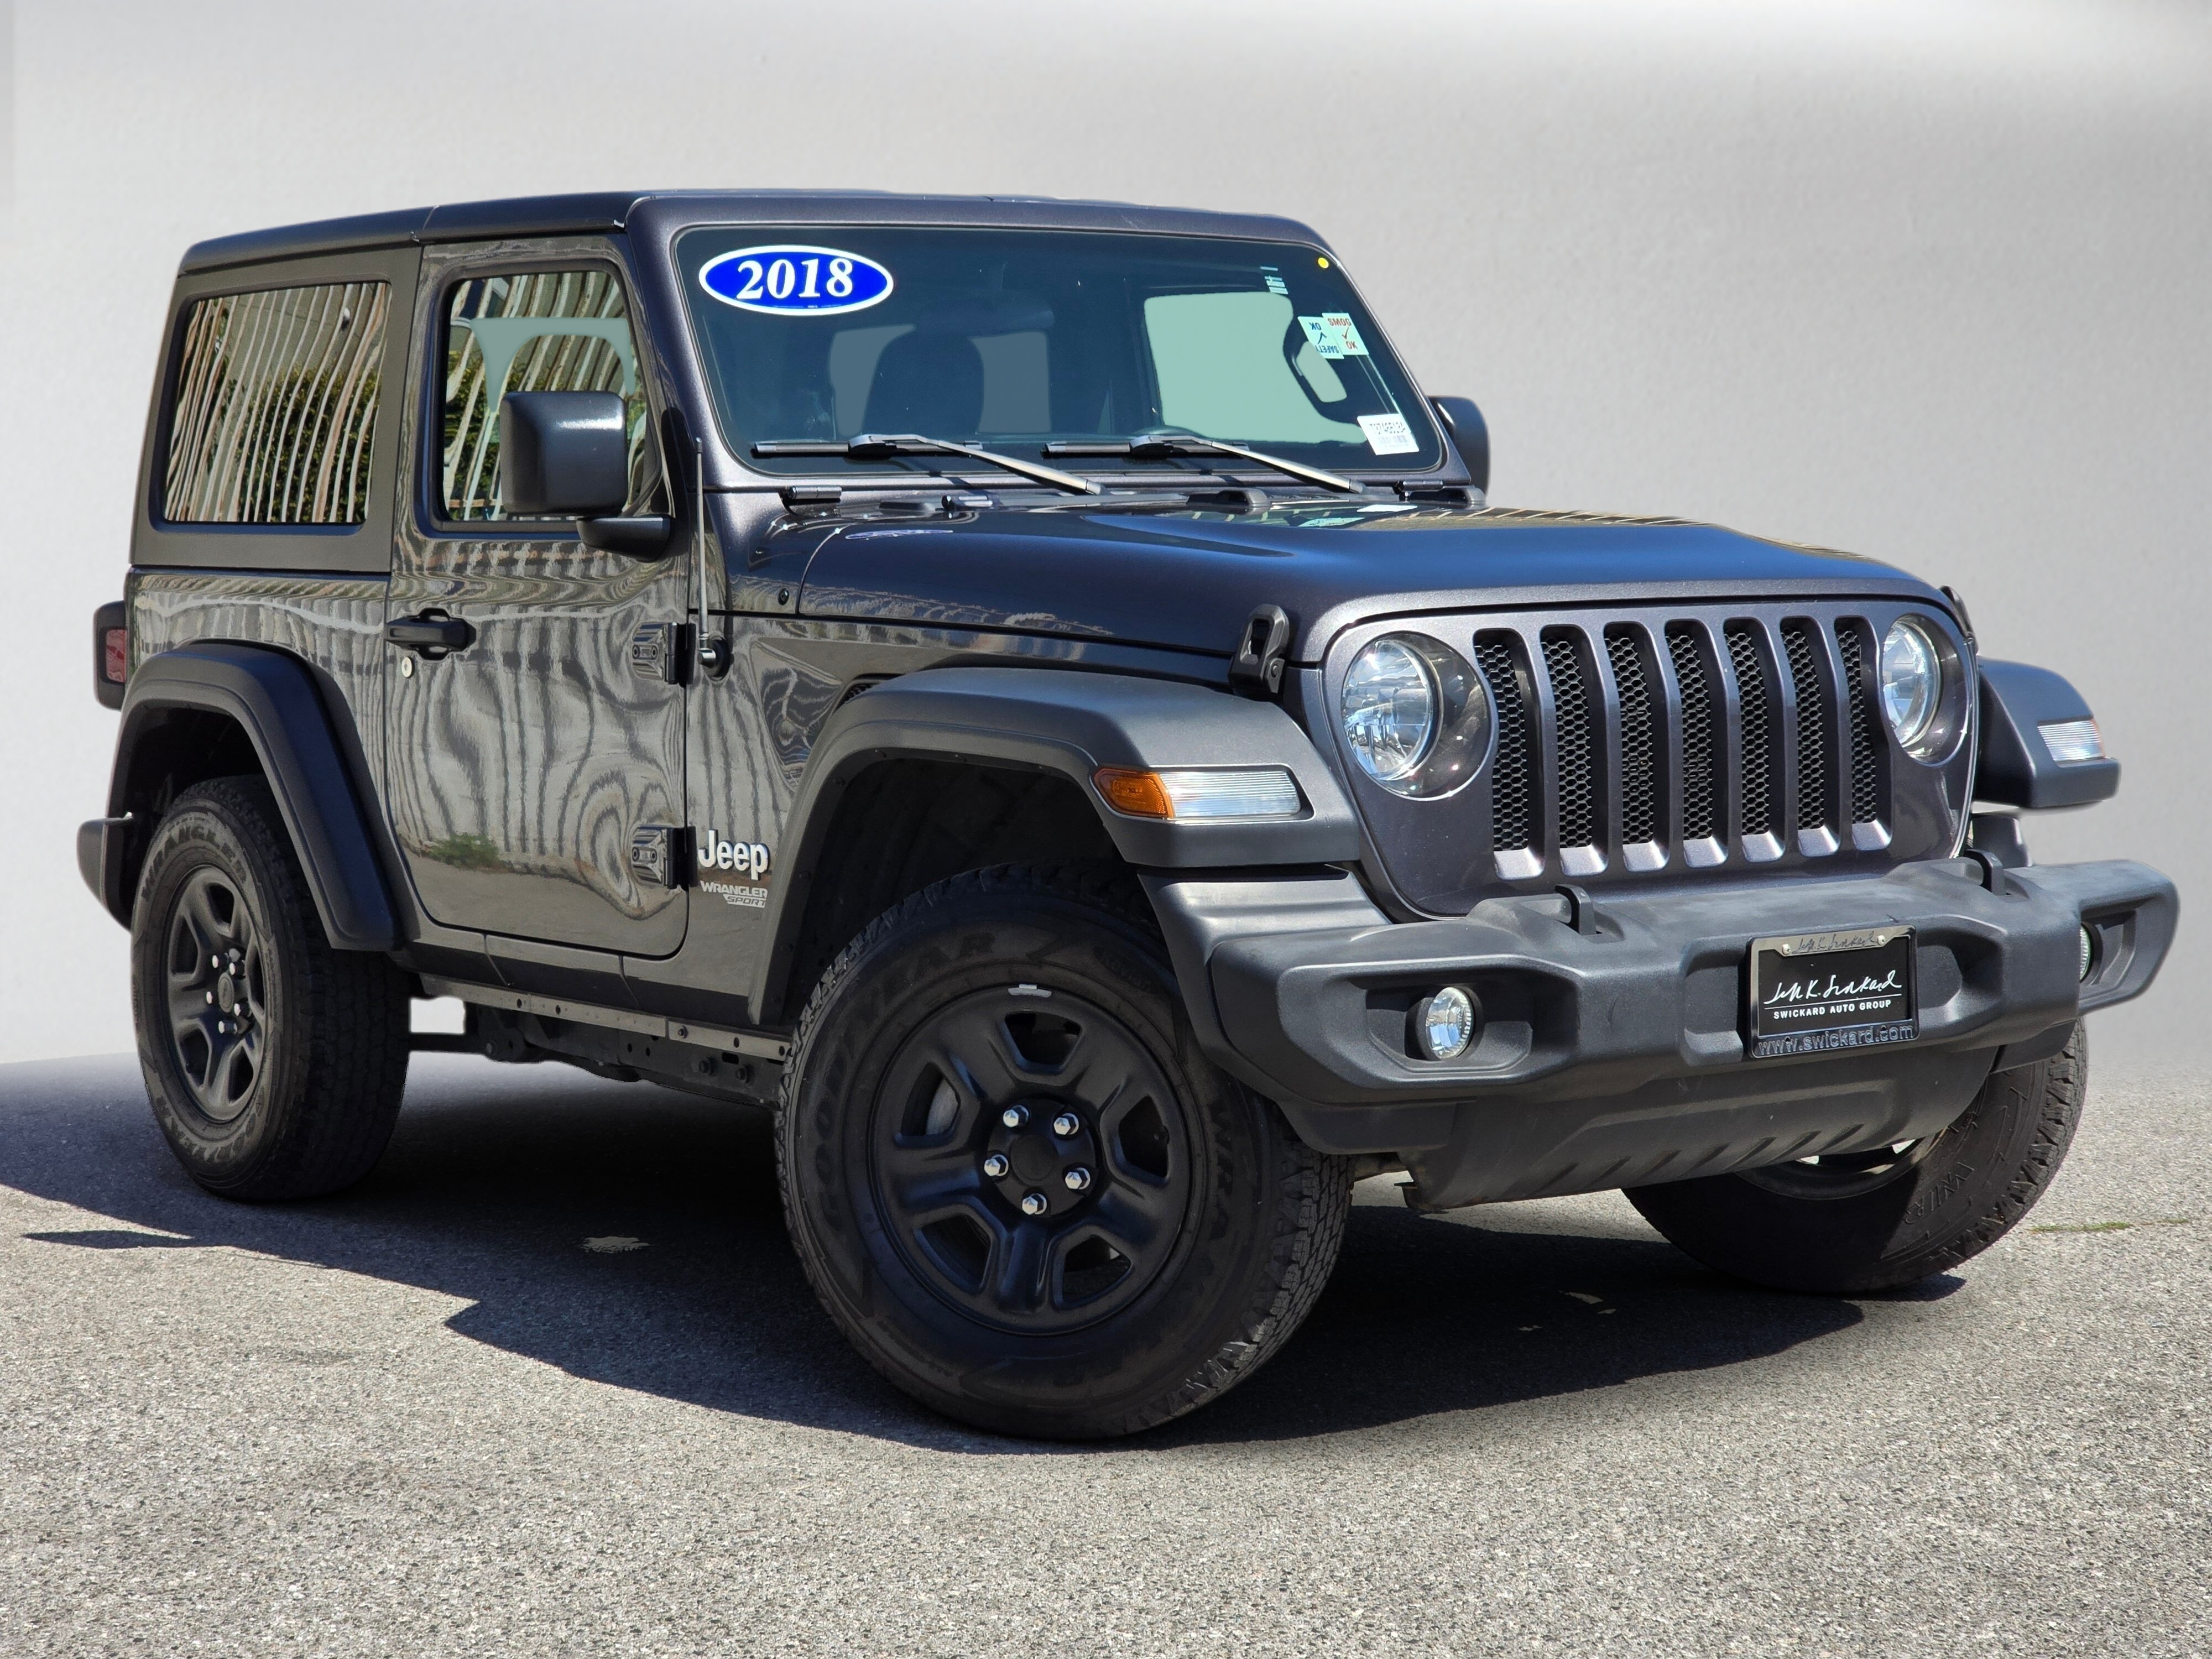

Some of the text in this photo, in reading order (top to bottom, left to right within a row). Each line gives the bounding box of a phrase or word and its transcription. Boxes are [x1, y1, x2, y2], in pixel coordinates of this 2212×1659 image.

[736, 258, 853, 299] 2018
[1310, 322, 1322, 331] OK
[1328, 318, 1352, 326] SMOG
[1345, 341, 1358, 349] OK
[698, 829, 770, 881] Jeep
[700, 880, 768, 899] WRANGLER
[727, 895, 765, 906] SPORT
[1773, 999, 1892, 1020] SWICKARD AUTO GROUP
[1757, 1025, 1914, 1055] www.swickard.com
